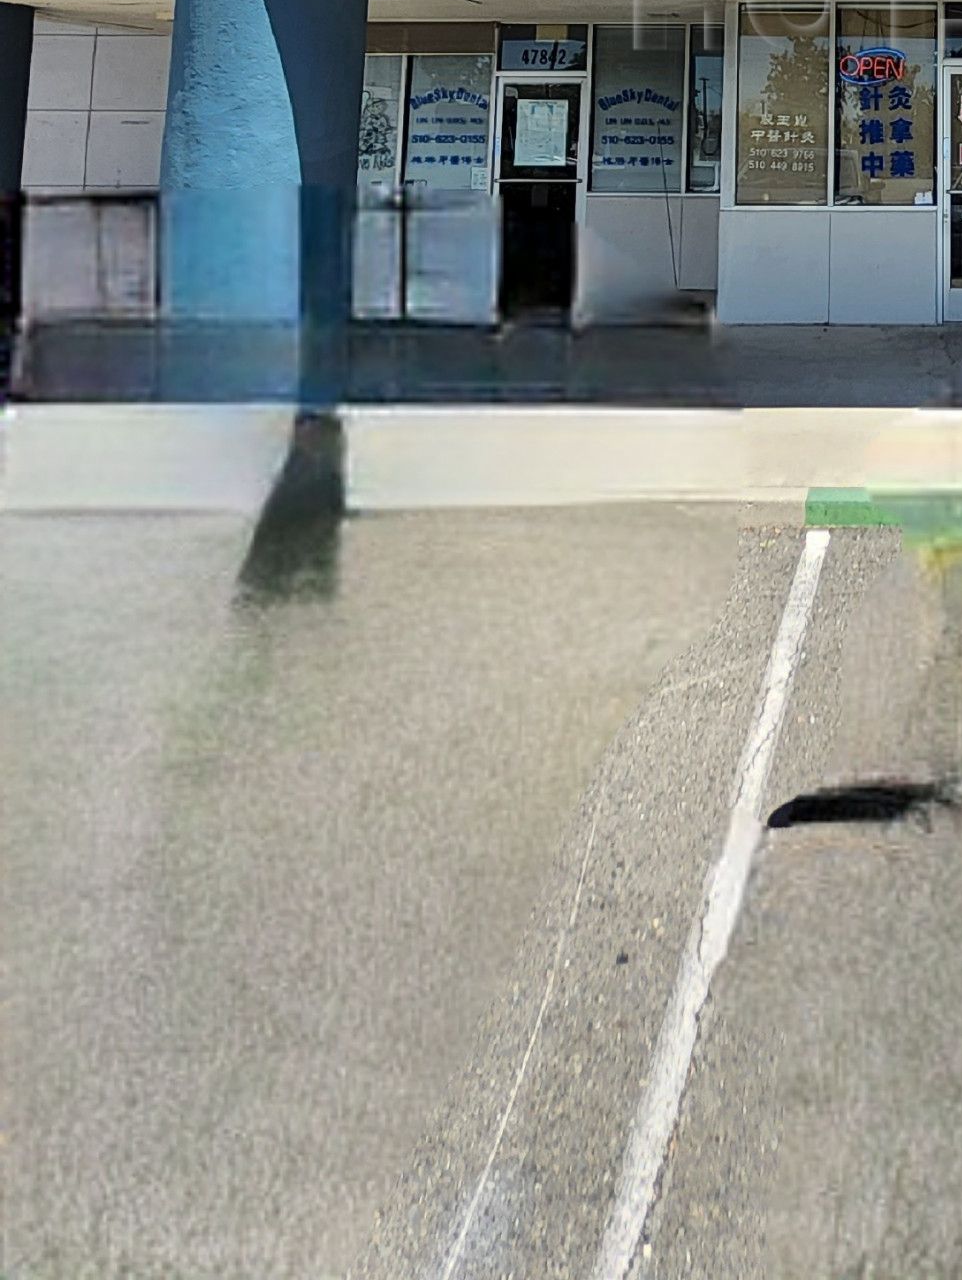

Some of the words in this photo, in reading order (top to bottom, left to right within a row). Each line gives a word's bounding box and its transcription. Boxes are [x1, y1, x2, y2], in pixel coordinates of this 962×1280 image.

[521, 48, 567, 65] 47842
[839, 55, 904, 81] OPEN
[859, 86, 915, 111] 針灸
[859, 118, 914, 145] 推拿
[749, 160, 766, 169] 510
[750, 148, 767, 157] 510
[861, 151, 915, 178] 中藥
